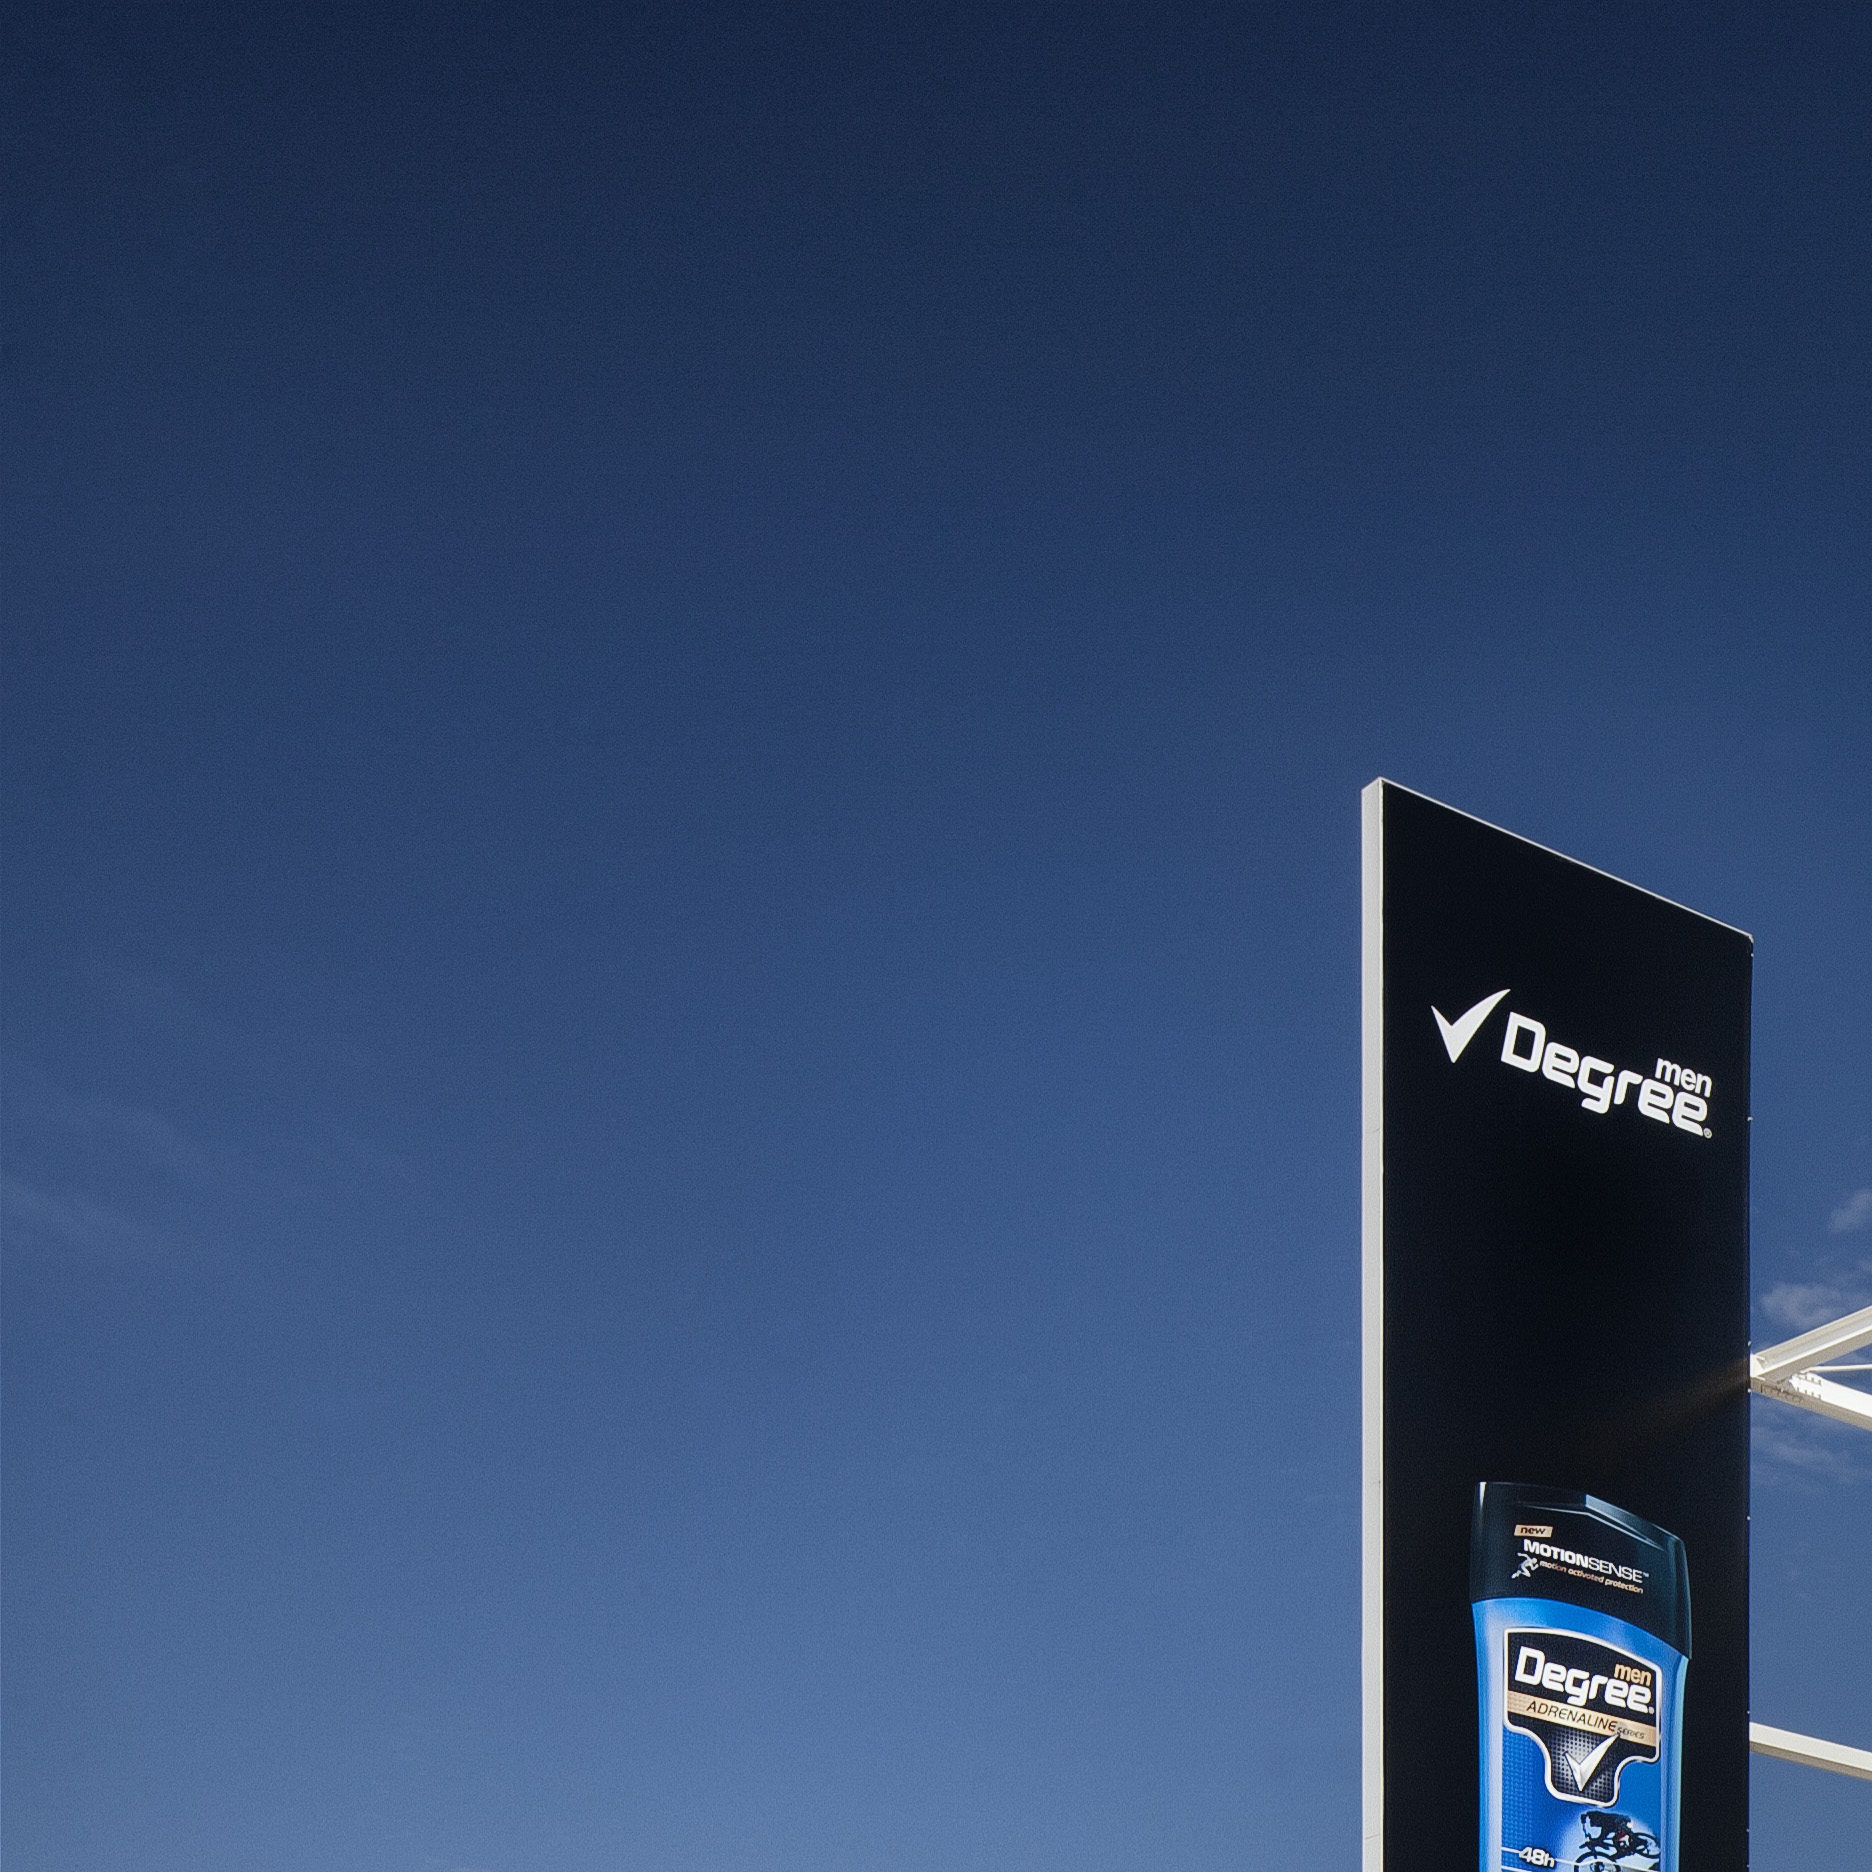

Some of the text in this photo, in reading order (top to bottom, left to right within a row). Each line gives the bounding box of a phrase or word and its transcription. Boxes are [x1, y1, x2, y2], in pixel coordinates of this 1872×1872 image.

[1657, 1057, 1712, 1097] men
[1520, 1527, 1546, 1535] new
[1540, 1561, 1644, 1595] motion activated protection
[1515, 1646, 1653, 1714] Degree
[1614, 1664, 1652, 1686] men
[1526, 1701, 1619, 1732] ADRENALINE
[1519, 1847, 1555, 1868] 48h
